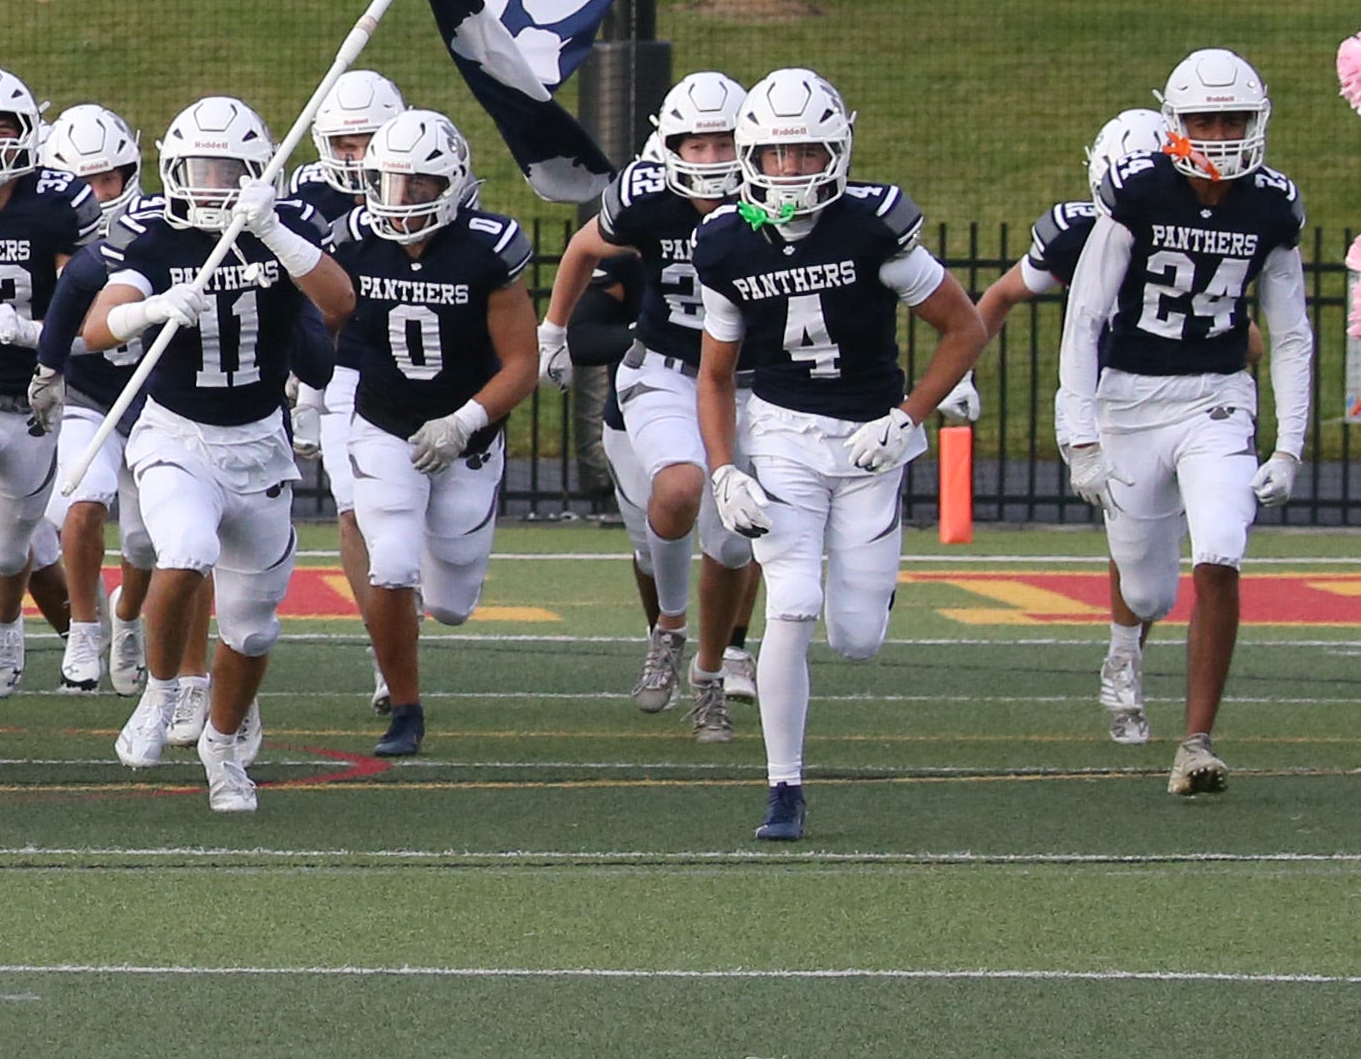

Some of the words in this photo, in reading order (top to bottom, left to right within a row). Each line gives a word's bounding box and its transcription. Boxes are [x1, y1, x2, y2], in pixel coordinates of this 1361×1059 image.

[772, 127, 807, 137] Riddell
[632, 167, 666, 195] 22
[1151, 224, 1259, 257] PANTHERS
[358, 275, 469, 305] PANTHERS
[733, 260, 857, 302] PANTHERS
[1136, 250, 1252, 341] 24
[196, 290, 262, 388] 11
[388, 304, 443, 380] 0
[783, 293, 841, 379] 4
